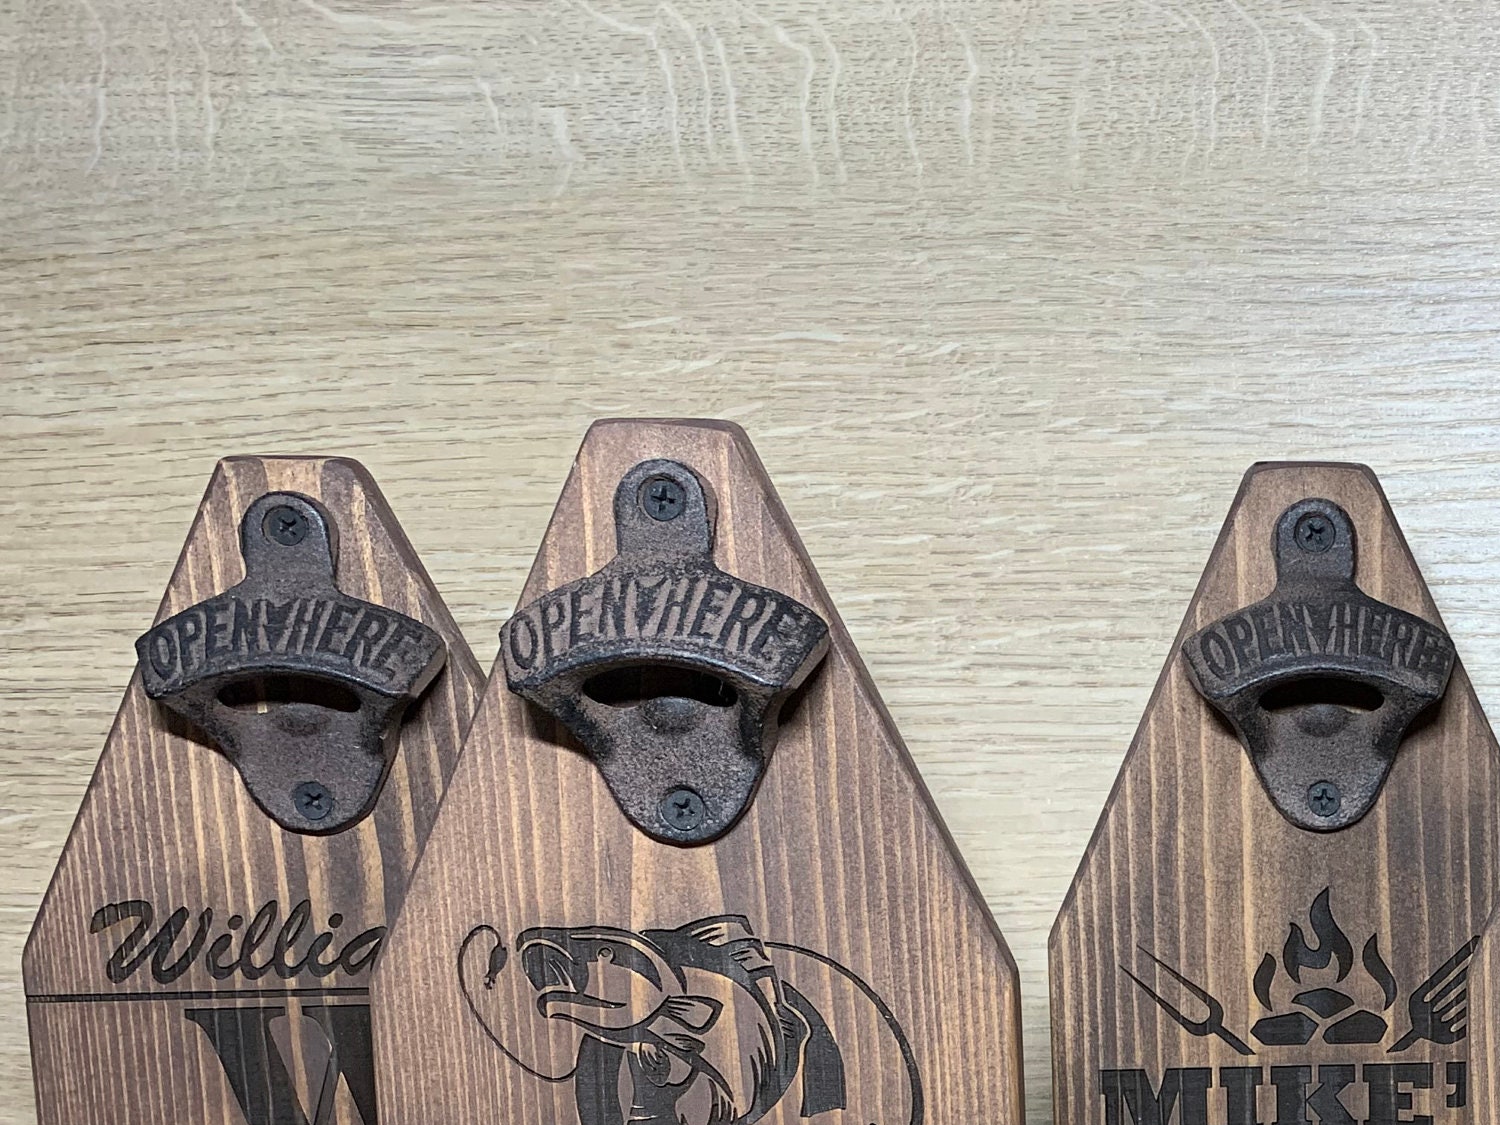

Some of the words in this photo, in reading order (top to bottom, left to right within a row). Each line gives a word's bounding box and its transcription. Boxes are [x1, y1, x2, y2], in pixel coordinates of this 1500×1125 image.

[150, 600, 270, 681] OPEN
[287, 599, 424, 682] HERE
[509, 574, 630, 670] OPEN
[656, 574, 814, 662] HERE
[1202, 602, 1314, 681] OPEN
[1331, 602, 1451, 676] HERE
